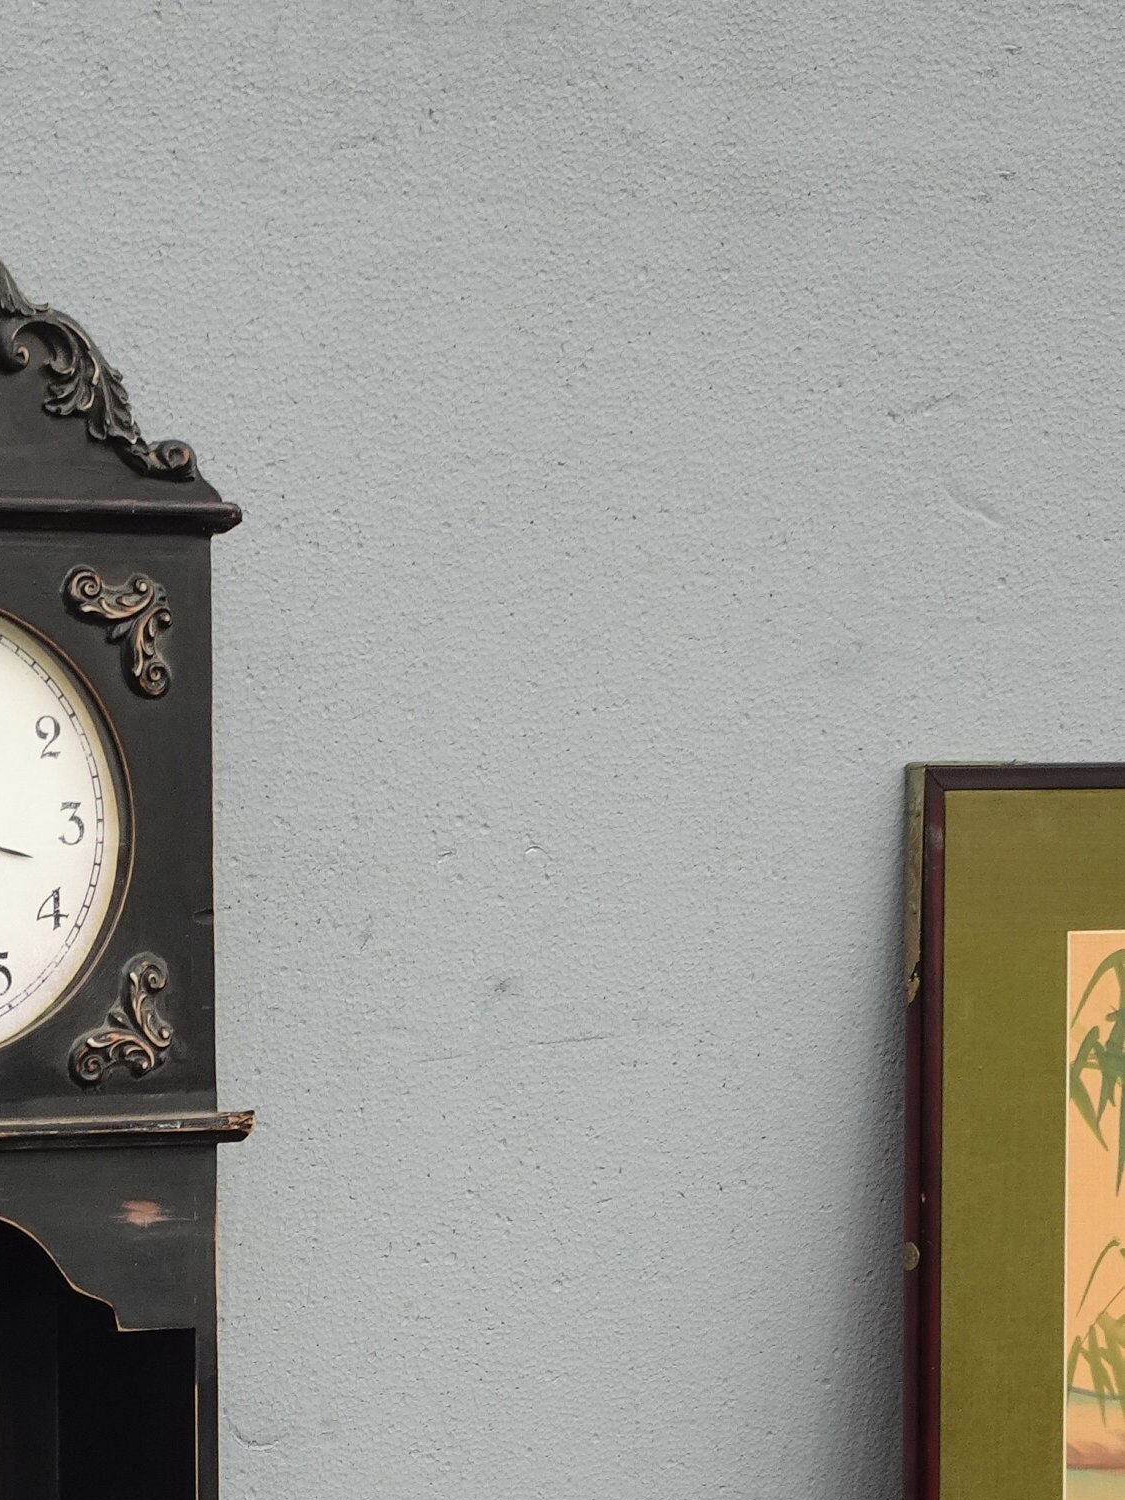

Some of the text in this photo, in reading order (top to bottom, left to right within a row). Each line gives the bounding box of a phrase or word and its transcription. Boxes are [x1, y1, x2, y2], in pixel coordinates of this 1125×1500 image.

[36, 716, 60, 758] 2
[59, 802, 84, 845] 3
[37, 886, 69, 931] 4
